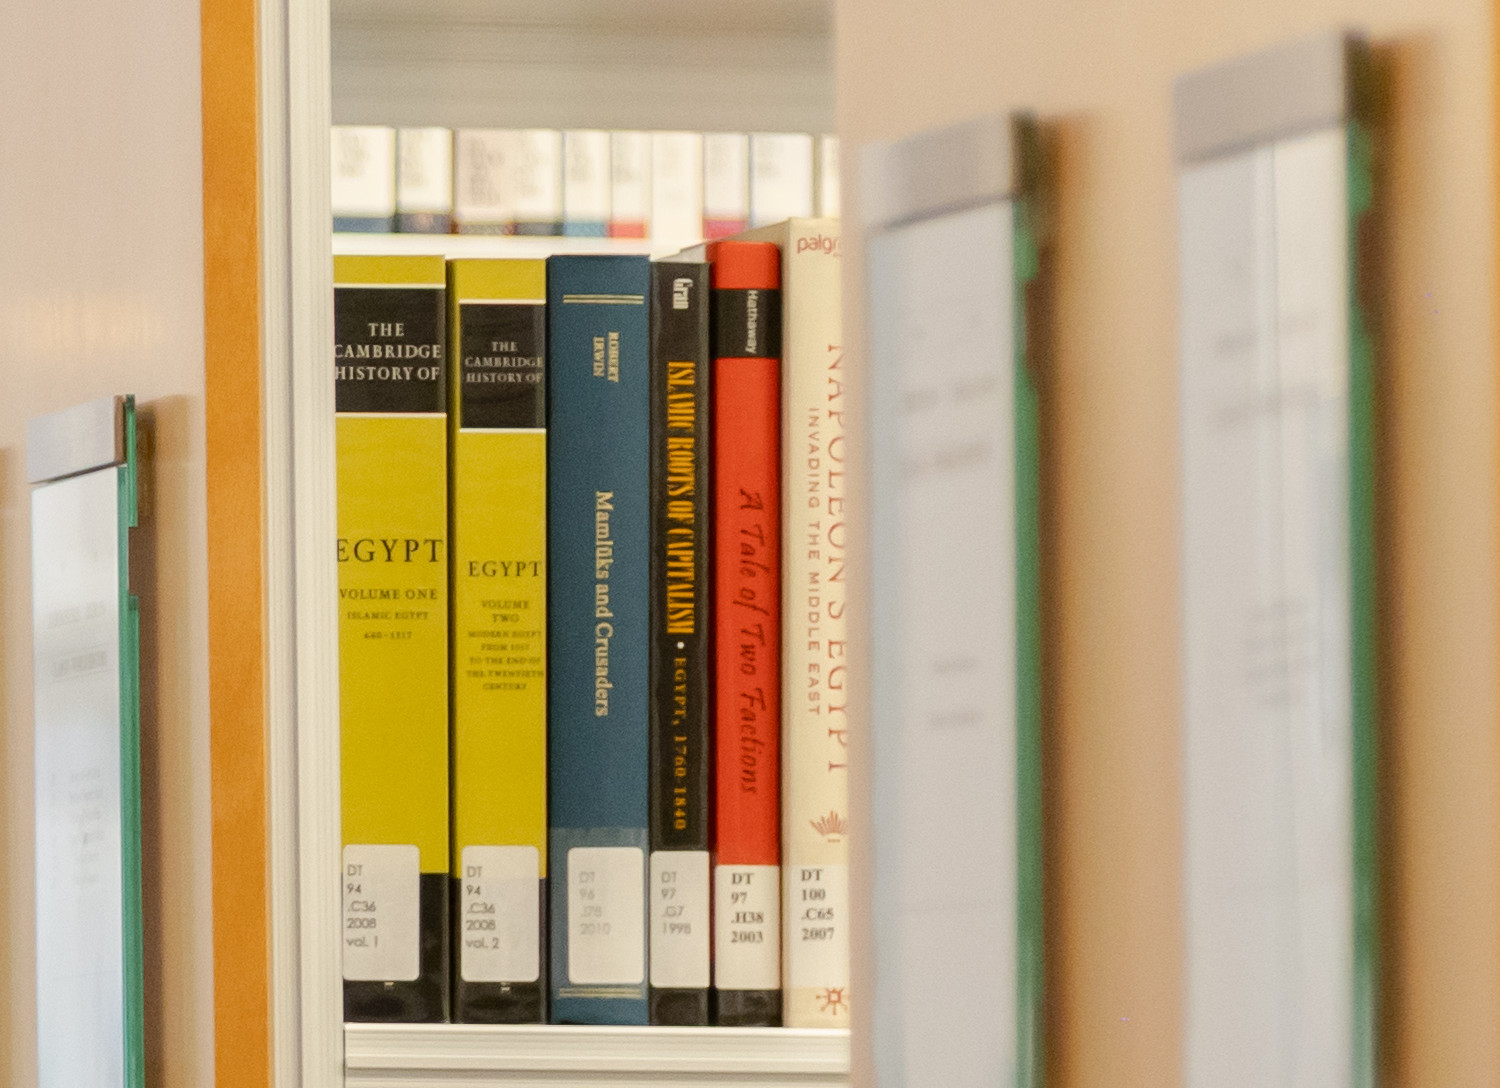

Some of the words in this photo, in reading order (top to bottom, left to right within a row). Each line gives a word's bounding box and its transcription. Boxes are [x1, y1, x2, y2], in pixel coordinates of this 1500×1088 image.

[368, 323, 405, 336] THE
[745, 289, 759, 354] Hathaway
[334, 344, 442, 359] CAMBRIDGE
[491, 341, 518, 352] THE
[465, 356, 543, 369] CAMBRIDGE
[592, 336, 605, 378] IRWIN
[334, 366, 412, 381] HISTORY
[416, 366, 441, 380] OF
[466, 372, 520, 384] HISTORY
[523, 371, 542, 384] OF
[667, 361, 695, 433] ISLAMIC
[667, 437, 695, 496] ROOTS
[807, 407, 820, 508] INVADING
[740, 488, 763, 510] A
[667, 500, 695, 526] OF
[336, 538, 443, 564] EGYPT
[740, 524, 768, 578] Tale
[807, 521, 820, 561] THE
[468, 560, 542, 578] EGYPT
[667, 528, 694, 634] CAPITALISM
[339, 588, 400, 601] VOLUME
[404, 588, 438, 601] ONE
[595, 583, 614, 618] and
[733, 587, 769, 616] of
[807, 572, 820, 651] MIDDLE
[740, 623, 764, 675] Two
[594, 622, 614, 717] Crusaders
[673, 657, 687, 726] EGYPT,
[807, 663, 820, 716] EAST
[740, 688, 766, 794] Factions
[347, 865, 362, 876] DT
[467, 867, 482, 878] DT
[731, 872, 754, 885] DT
[801, 869, 822, 882] DT
[347, 884, 361, 894] 94
[466, 886, 481, 896] 94
[731, 892, 748, 904] 97
[801, 888, 826, 901] 100
[347, 918, 376, 929] 2008
[730, 930, 763, 943] 2003
[801, 928, 834, 941] 2007
